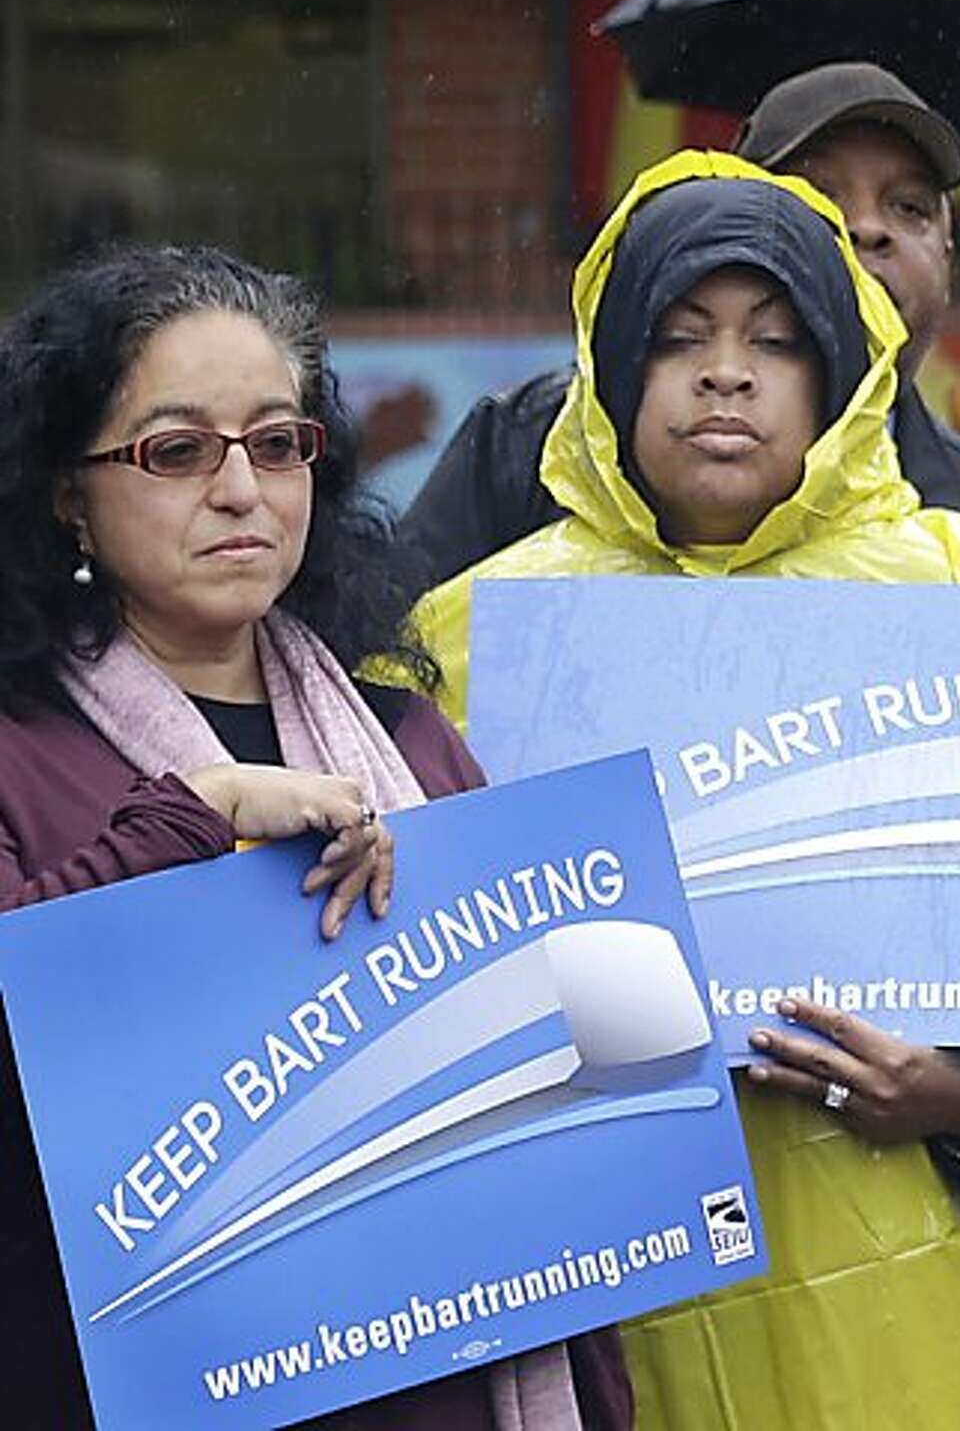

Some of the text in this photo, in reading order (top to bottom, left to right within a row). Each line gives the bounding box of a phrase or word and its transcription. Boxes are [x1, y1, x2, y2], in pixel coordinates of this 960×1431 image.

[679, 696, 843, 799] BART
[95, 848, 626, 1251] KEEP BART RUNNING
[204, 1221, 692, 1401] www.keepbartrunning.com
